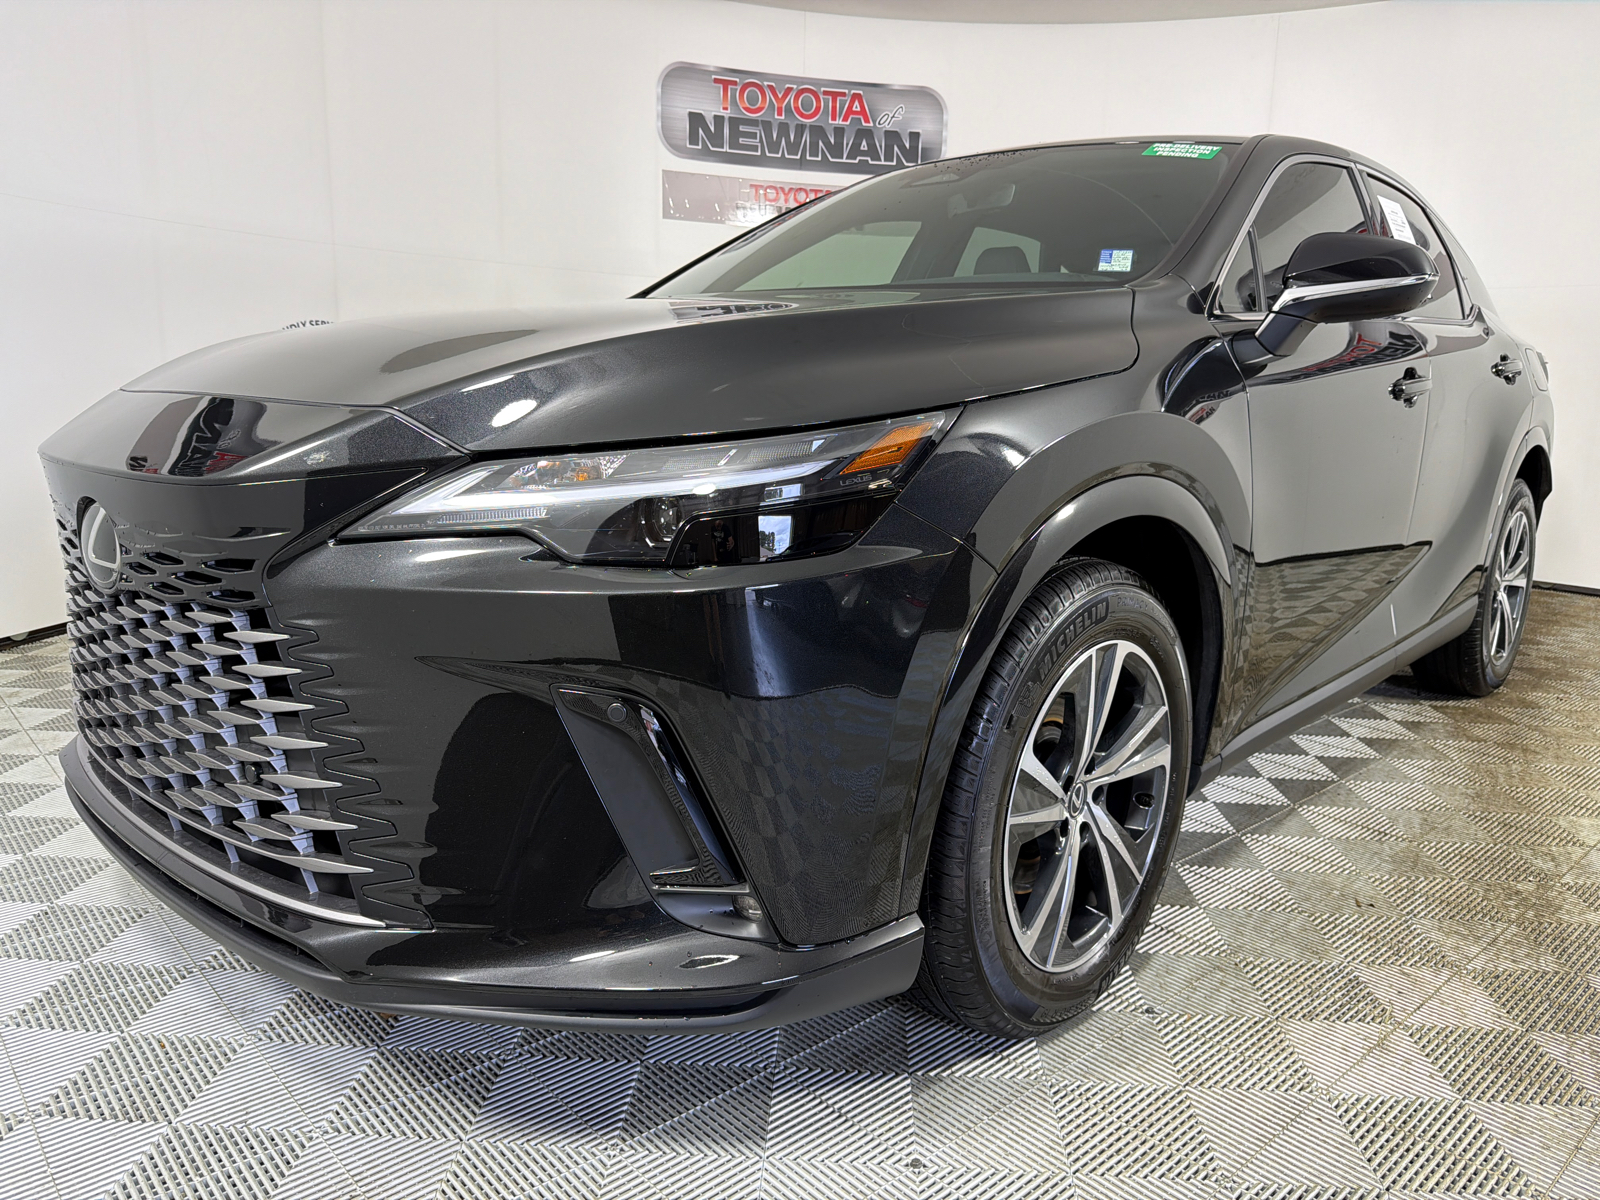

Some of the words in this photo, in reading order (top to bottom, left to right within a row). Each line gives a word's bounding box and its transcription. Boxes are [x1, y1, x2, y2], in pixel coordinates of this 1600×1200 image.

[712, 76, 873, 126] TOYOTA
[876, 105, 904, 127] of
[686, 110, 921, 165] NEWNAN
[1153, 143, 1220, 151] PRE-DELIVERY
[840, 475, 872, 486] LEXUS
[1038, 601, 1107, 682] MICHELIN
